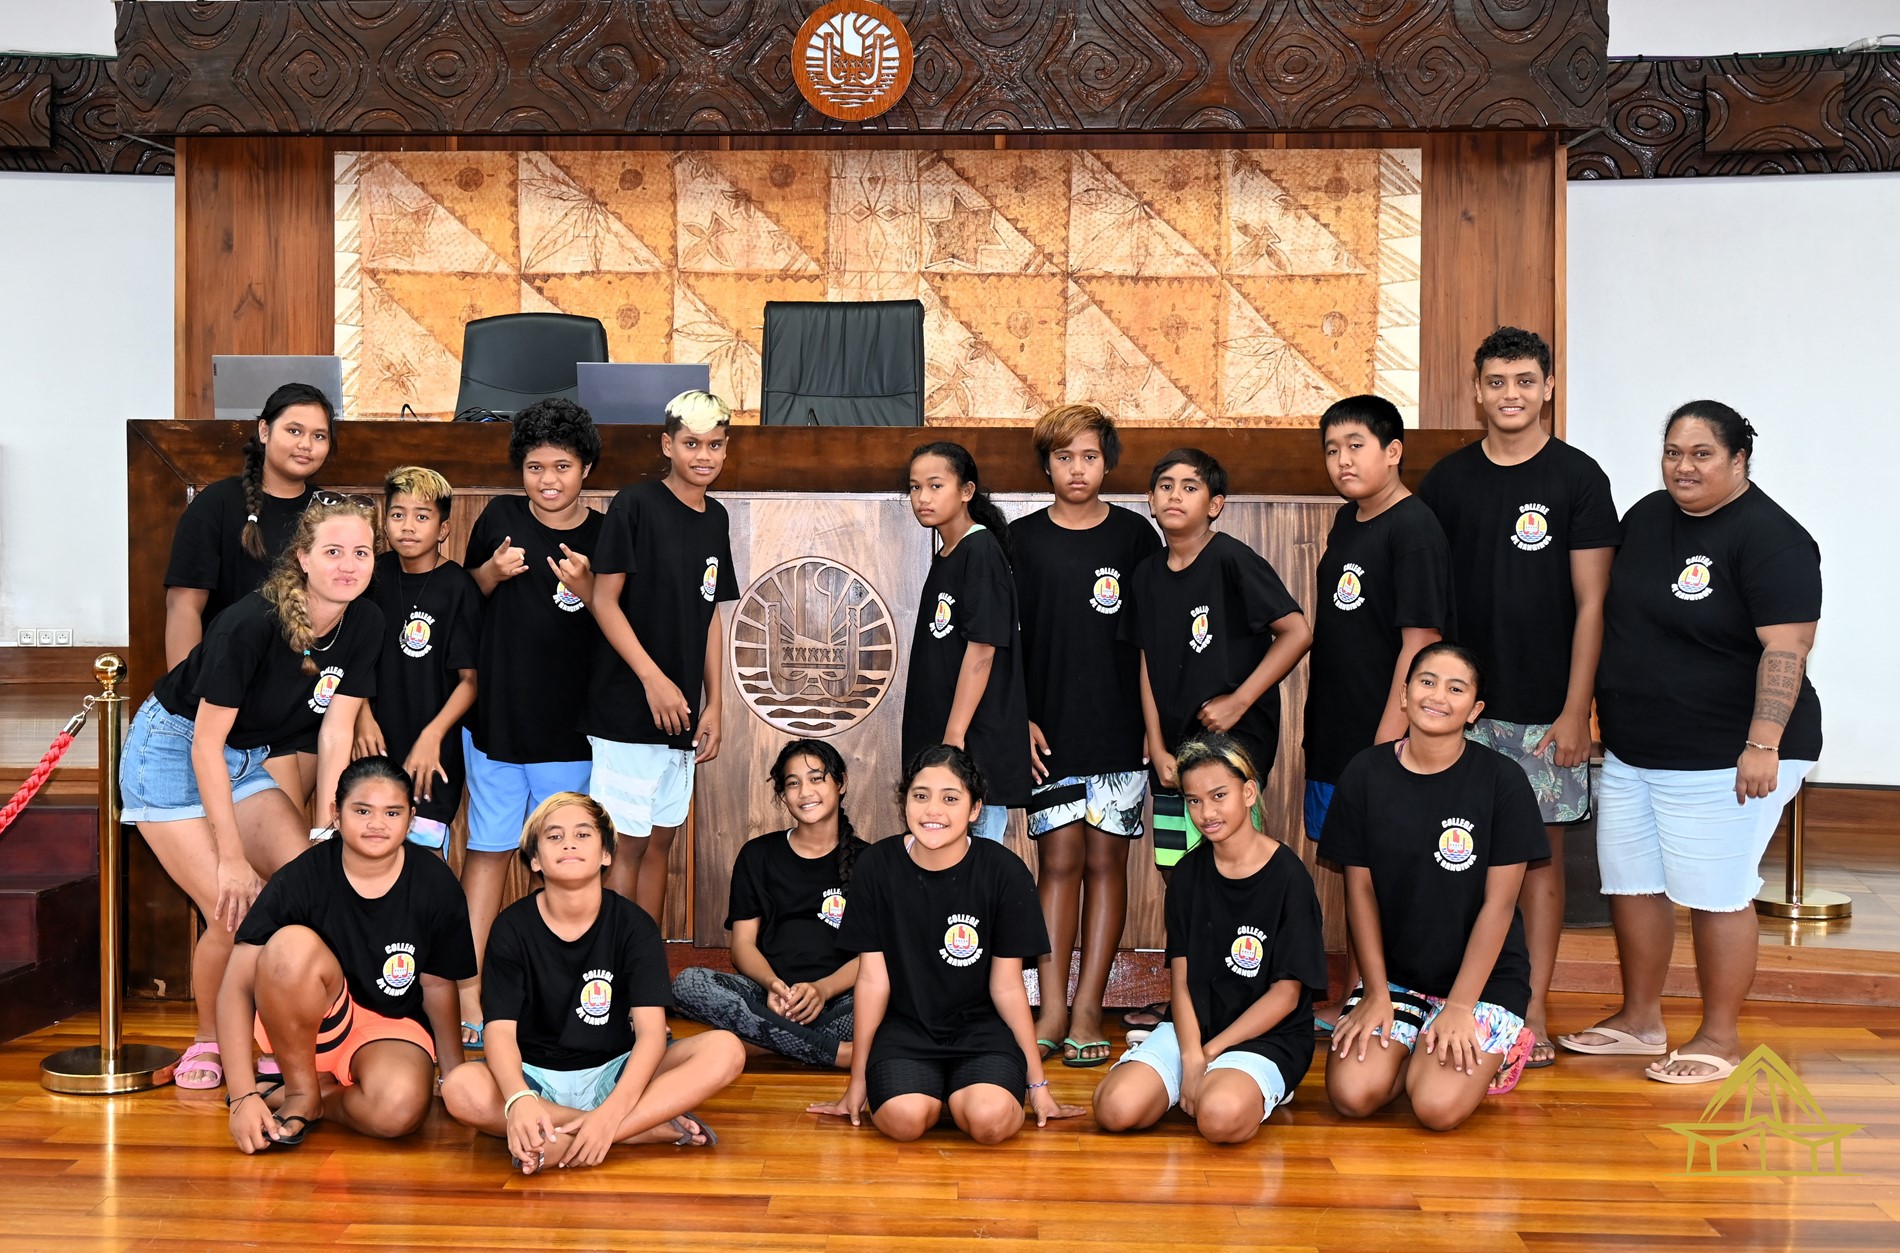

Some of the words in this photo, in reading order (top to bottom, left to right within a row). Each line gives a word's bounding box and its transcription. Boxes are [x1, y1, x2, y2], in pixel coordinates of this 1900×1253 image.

[1519, 503, 1550, 516] COLLEGE
[1510, 534, 1518, 545] DE
[1517, 535, 1552, 551] RANGIROA
[1686, 555, 1713, 567] COLLEGE
[1671, 583, 1678, 593] DE
[1674, 587, 1713, 601] RANGIROA
[1441, 818, 1475, 832] COLLEGE
[1434, 851, 1442, 863] DE
[1440, 854, 1477, 872] RANGIROA
[823, 888, 842, 898] COLLE
[947, 914, 980, 928] COLLEGE
[1237, 926, 1268, 942] COLLEGE
[938, 948, 947, 960] DE
[946, 948, 983, 967] RANGIROA
[1225, 956, 1233, 968] DE
[376, 978, 385, 989] DE
[576, 1006, 584, 1019] DE
